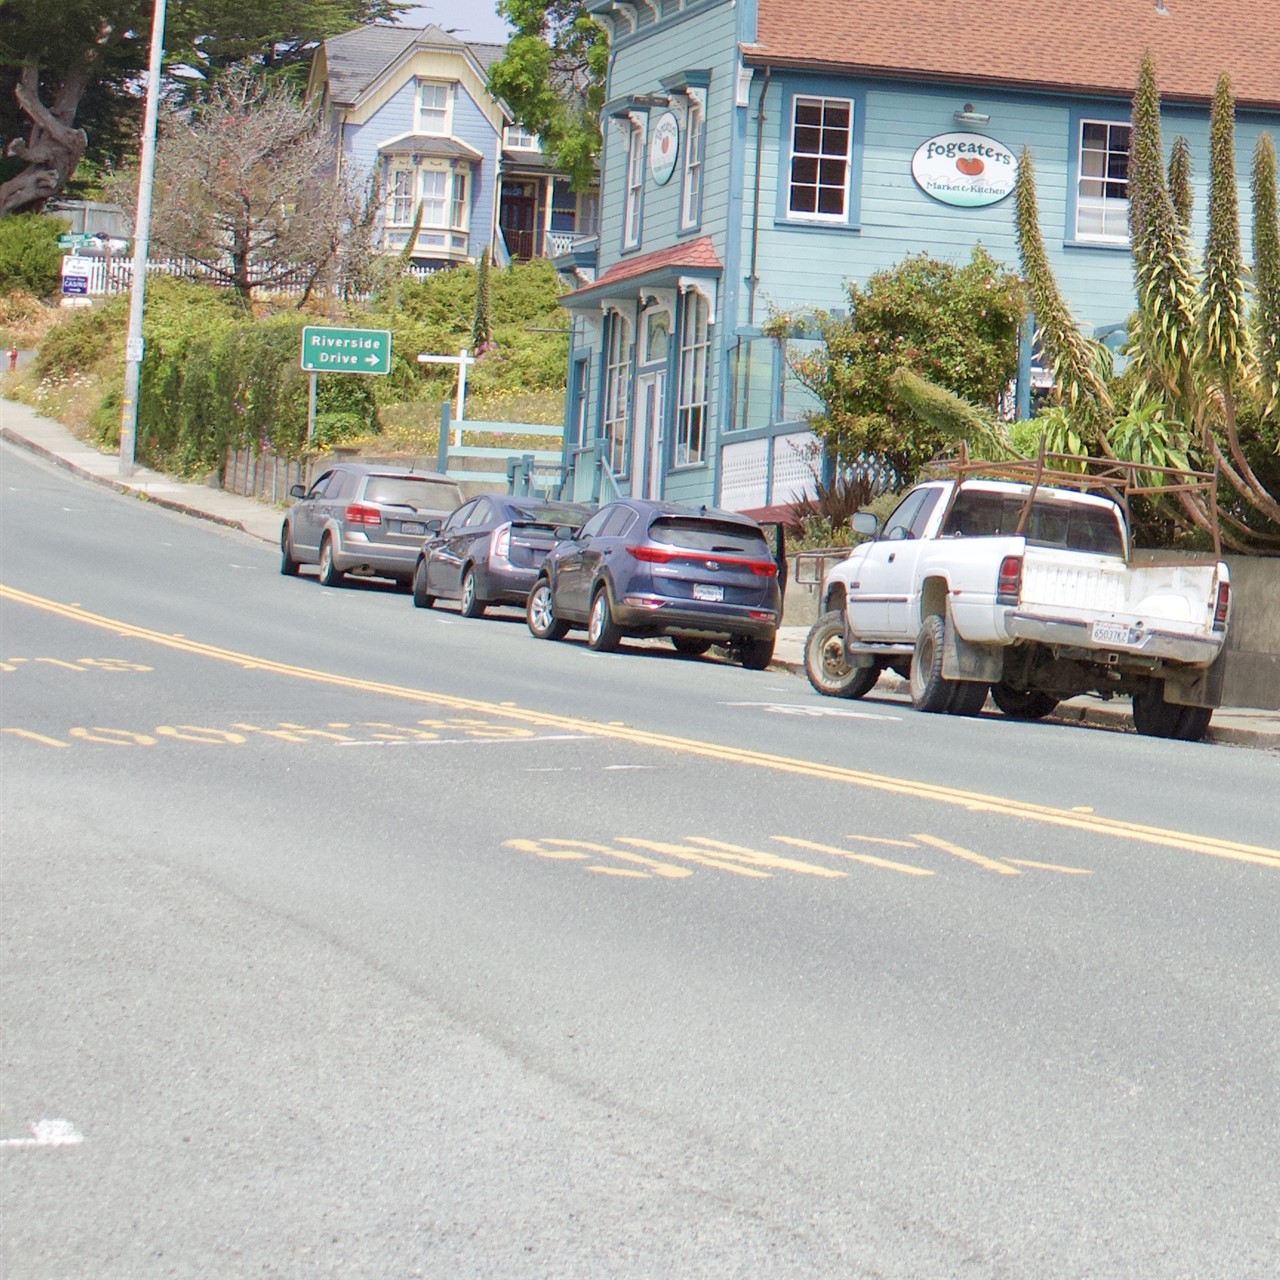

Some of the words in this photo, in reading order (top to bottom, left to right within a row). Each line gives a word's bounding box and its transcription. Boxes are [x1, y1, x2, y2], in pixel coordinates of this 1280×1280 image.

[926, 141, 1011, 165] fogeaters
[926, 181, 960, 191] Market
[970, 184, 1006, 195] Kitchen
[64, 280, 88, 288] CASINO
[311, 335, 381, 349] Riverside
[320, 352, 358, 364] Drive
